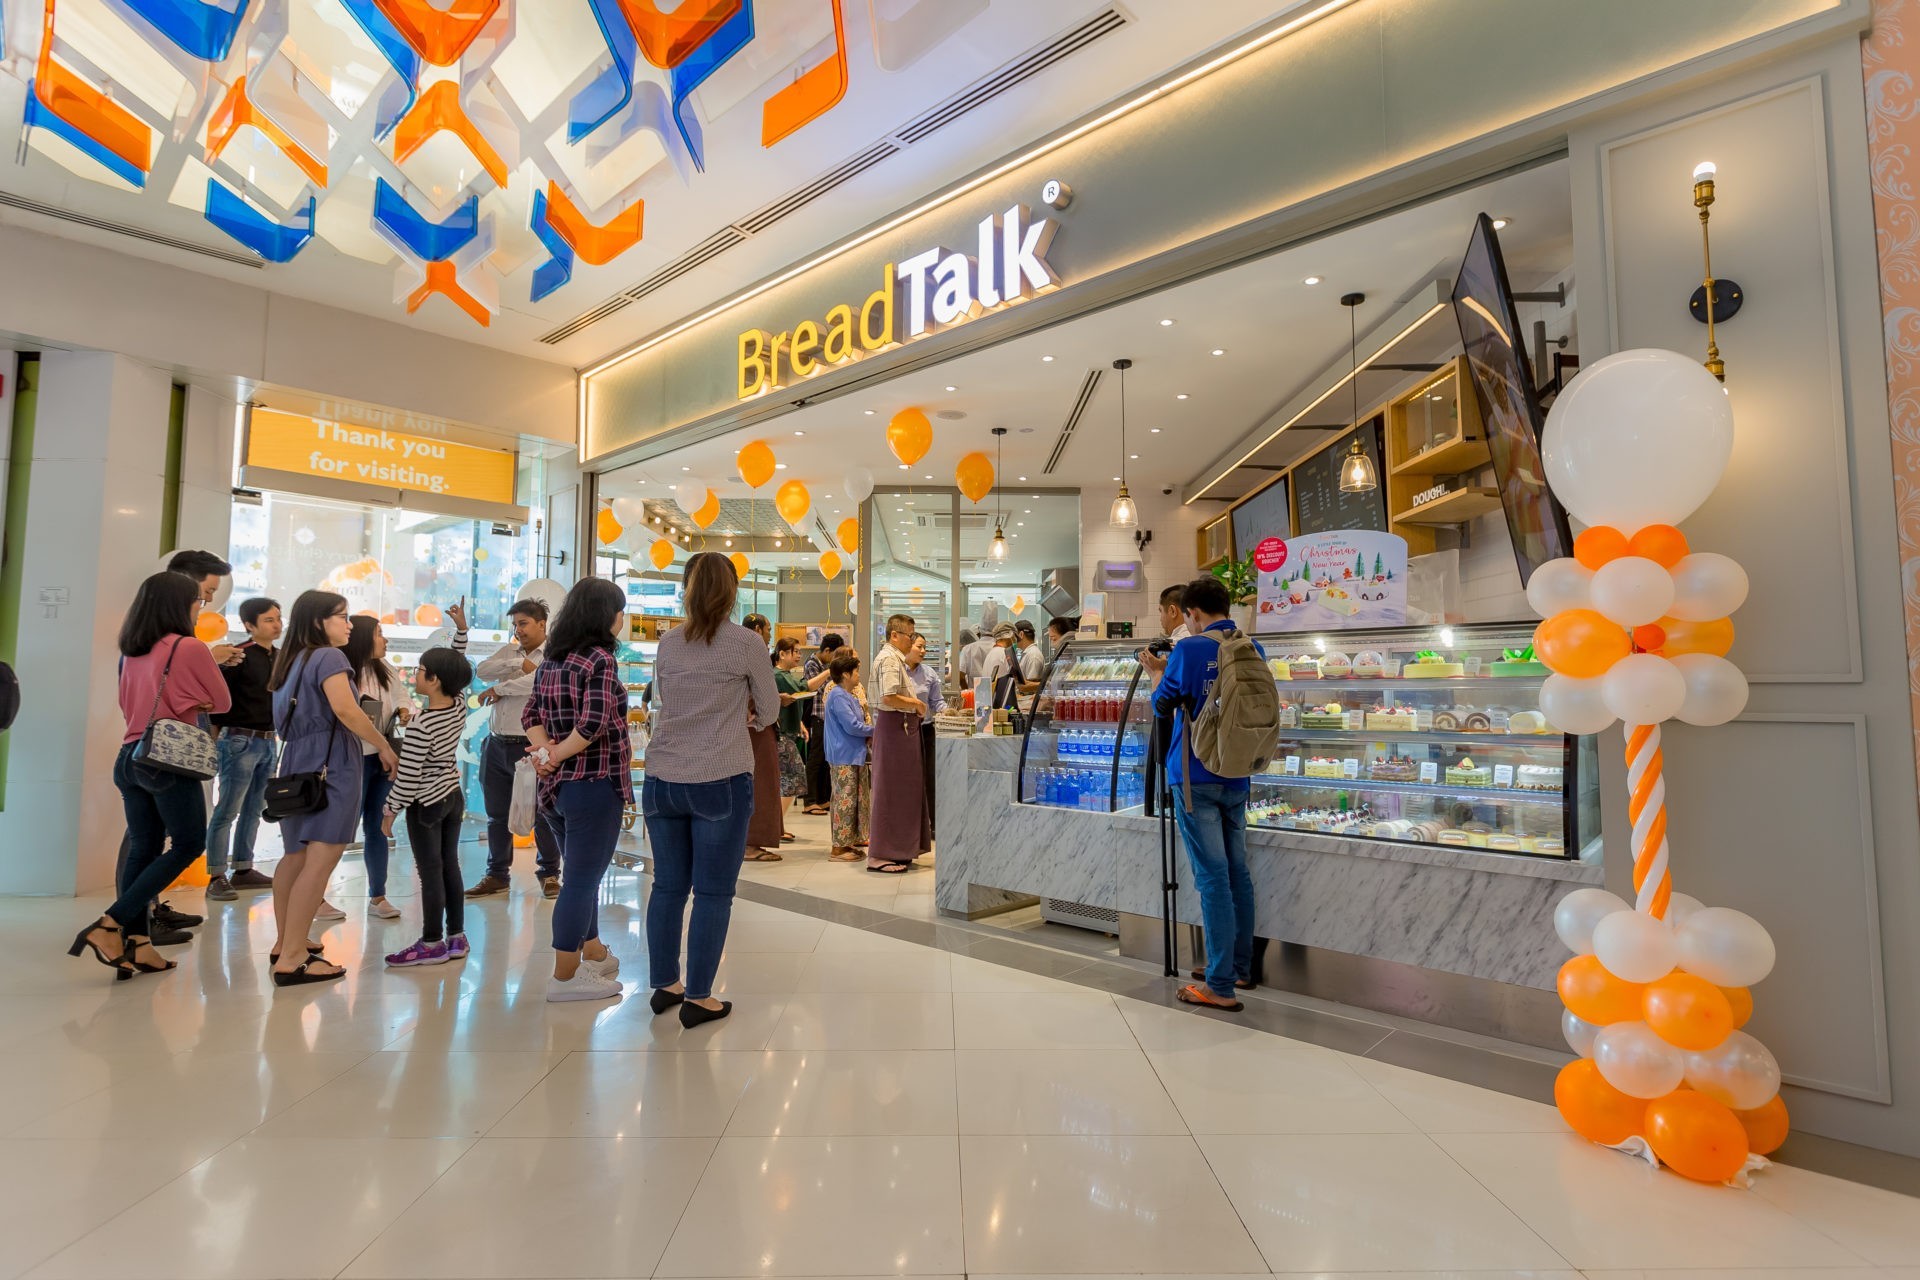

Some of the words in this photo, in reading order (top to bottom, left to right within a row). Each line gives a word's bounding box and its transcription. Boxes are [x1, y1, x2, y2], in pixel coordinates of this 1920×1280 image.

[738, 203, 1052, 400] BreadTalk
[311, 417, 395, 450] Thank
[402, 438, 446, 459] you
[309, 451, 349, 473] for
[356, 460, 449, 493] visiting.
[1300, 546, 1357, 561] Christmas
